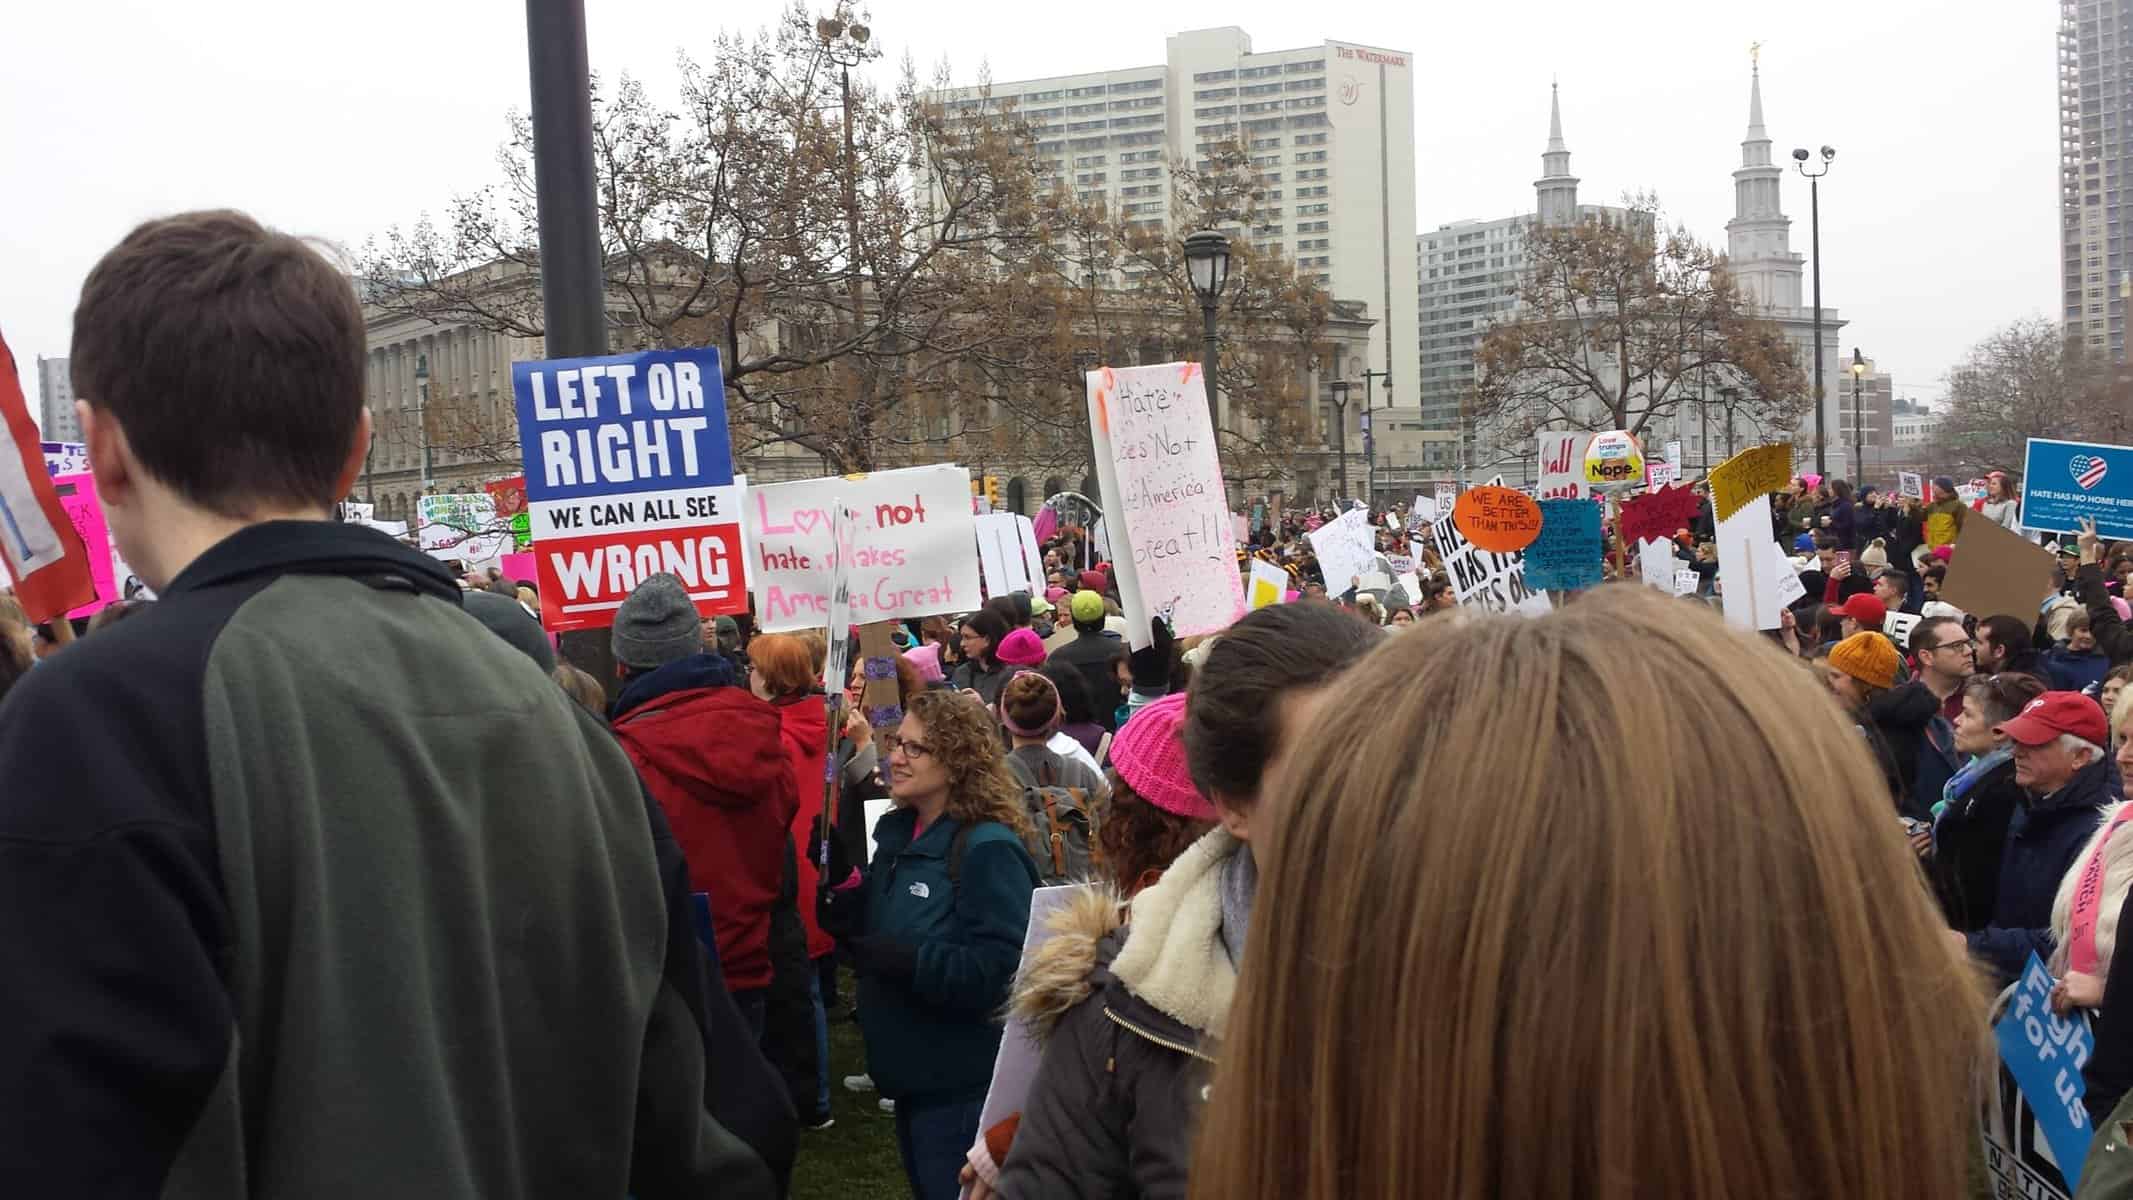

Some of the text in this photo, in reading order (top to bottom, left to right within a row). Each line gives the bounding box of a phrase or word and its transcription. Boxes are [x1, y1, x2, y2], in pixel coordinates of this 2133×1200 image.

[1336, 46, 1353, 58] THE
[530, 361, 704, 421] LEFT OR
[1119, 380, 1171, 415] Hate
[541, 416, 708, 488] RIGHT
[1155, 424, 1198, 460] Not
[1592, 464, 1637, 477] Nope.
[1142, 477, 1204, 508] America
[1472, 491, 1525, 508] WE ARE
[2030, 489, 2053, 499] HATE
[2053, 492, 2071, 501] HAS
[2072, 493, 2087, 502] NO
[2088, 495, 2116, 506] HOME
[550, 507, 583, 529] WE
[591, 502, 635, 527] CAN
[643, 499, 680, 523] ALL
[687, 495, 718, 518] SEE
[876, 493, 925, 529] not
[1482, 506, 1529, 519] BETTER
[551, 536, 730, 600] WRONG
[1453, 549, 1488, 592] HAS
[766, 584, 870, 622] Ameca
[875, 576, 953, 611] Great
[2055, 1068, 2089, 1129] us
